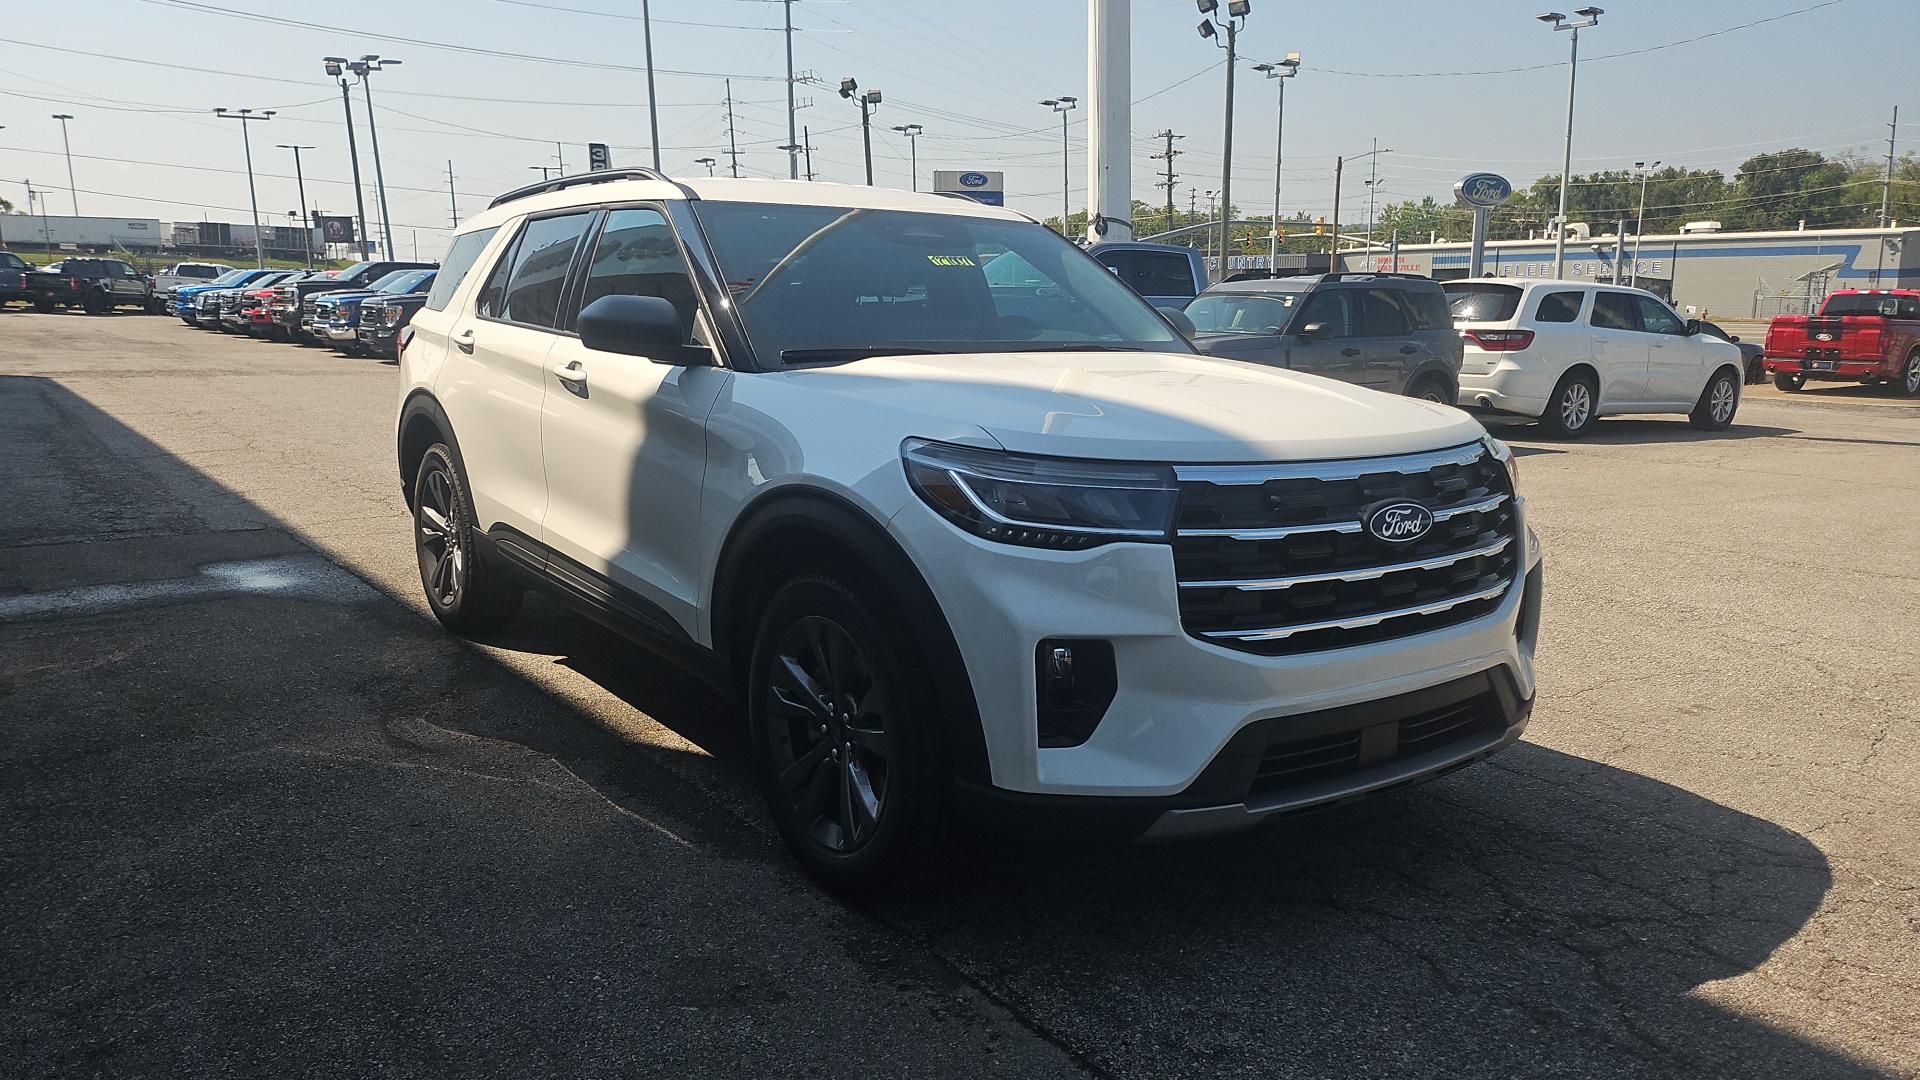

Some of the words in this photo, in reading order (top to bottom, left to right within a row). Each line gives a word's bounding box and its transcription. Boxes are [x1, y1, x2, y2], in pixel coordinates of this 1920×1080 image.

[966, 175, 984, 185] Ford
[1472, 179, 1504, 200] Ford
[1377, 264, 1421, 272] NASVILLE
[1503, 262, 1557, 277] FLEE
[1571, 260, 1663, 277] SERICE
[1382, 508, 1423, 537] Ford
